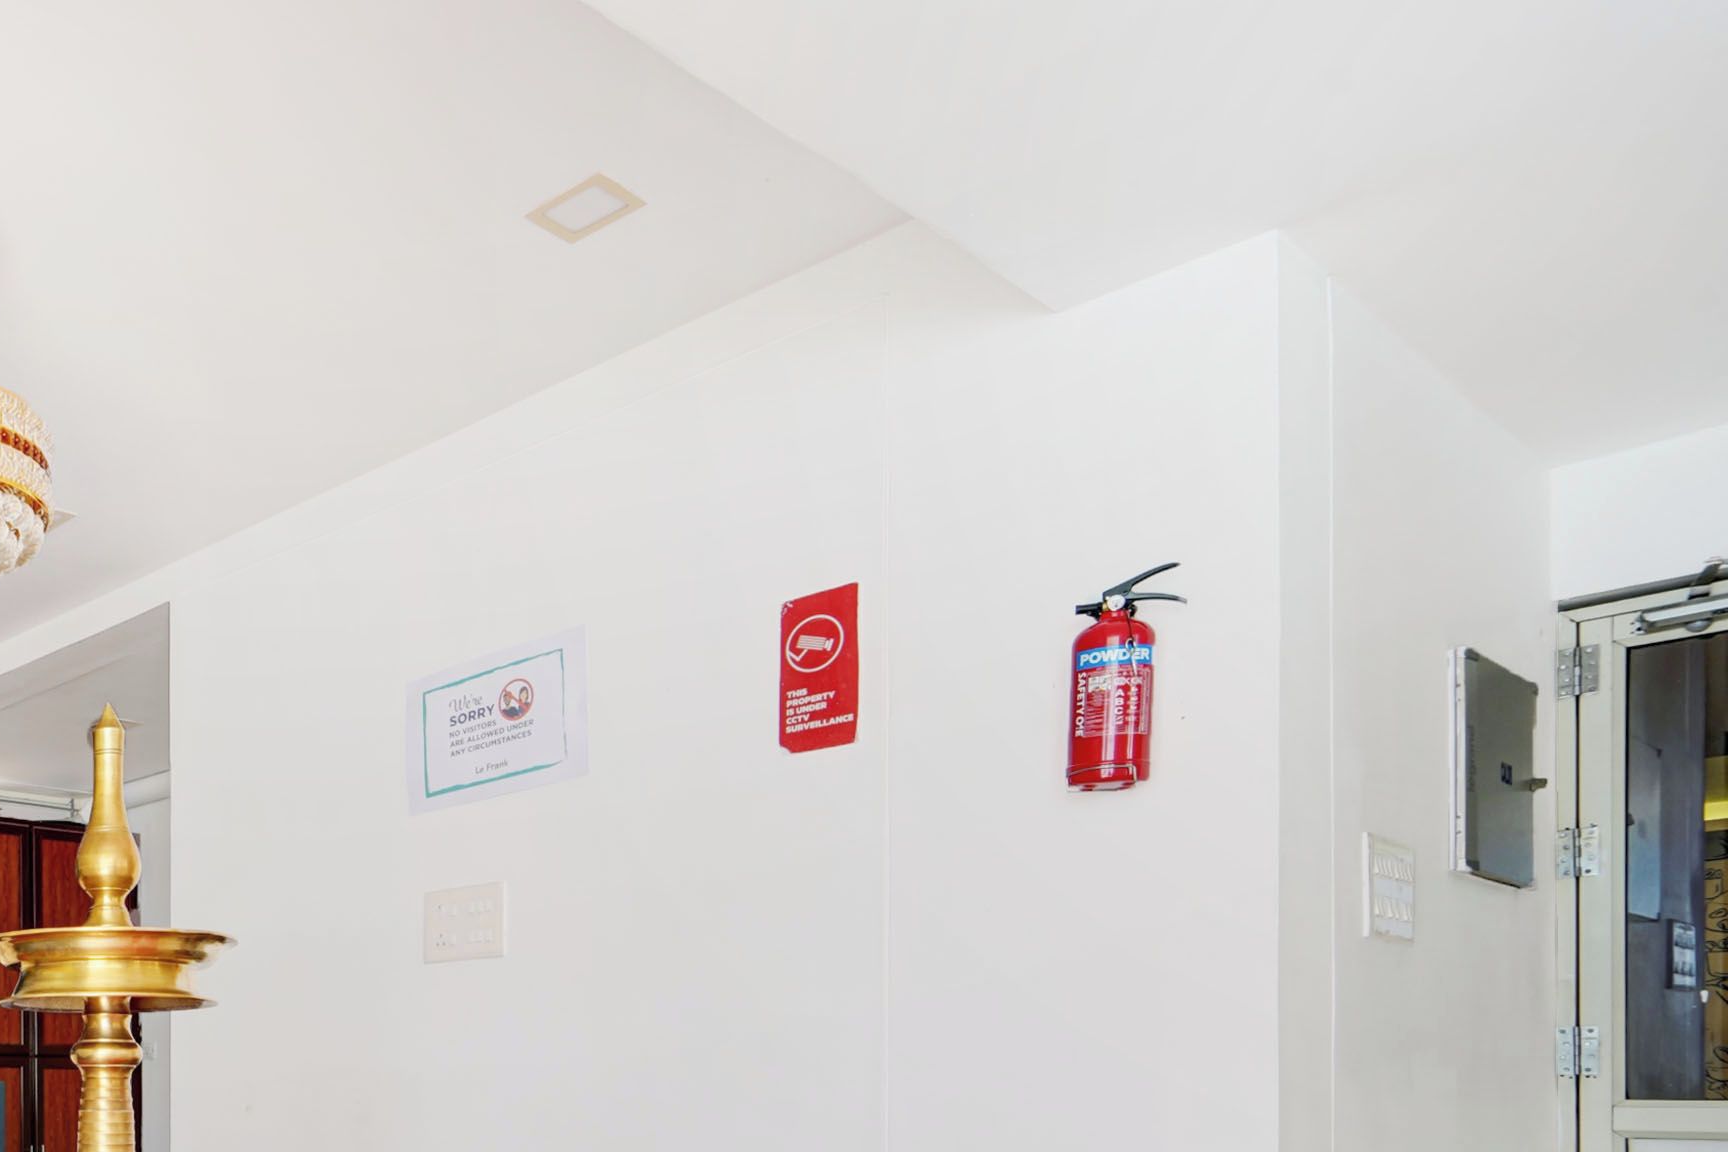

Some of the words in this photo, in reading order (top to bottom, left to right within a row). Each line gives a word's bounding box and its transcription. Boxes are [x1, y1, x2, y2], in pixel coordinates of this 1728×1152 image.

[1080, 648, 1150, 666] POWDER
[786, 688, 807, 699] THIS
[786, 691, 835, 708] PROPERTY
[1077, 672, 1087, 714] SAFETY
[449, 703, 495, 728] SORRY
[796, 701, 828, 715] UNDER
[449, 730, 461, 739] NO
[462, 719, 497, 735] VISITORS
[785, 713, 810, 725] CCTV
[786, 714, 854, 734] SURVEILLANCE
[450, 738, 465, 748] ARE
[467, 726, 505, 743] ALLOWED
[506, 719, 534, 732] UNDER
[450, 747, 466, 758] ANY
[467, 729, 533, 753] CIRCUMSTANCES
